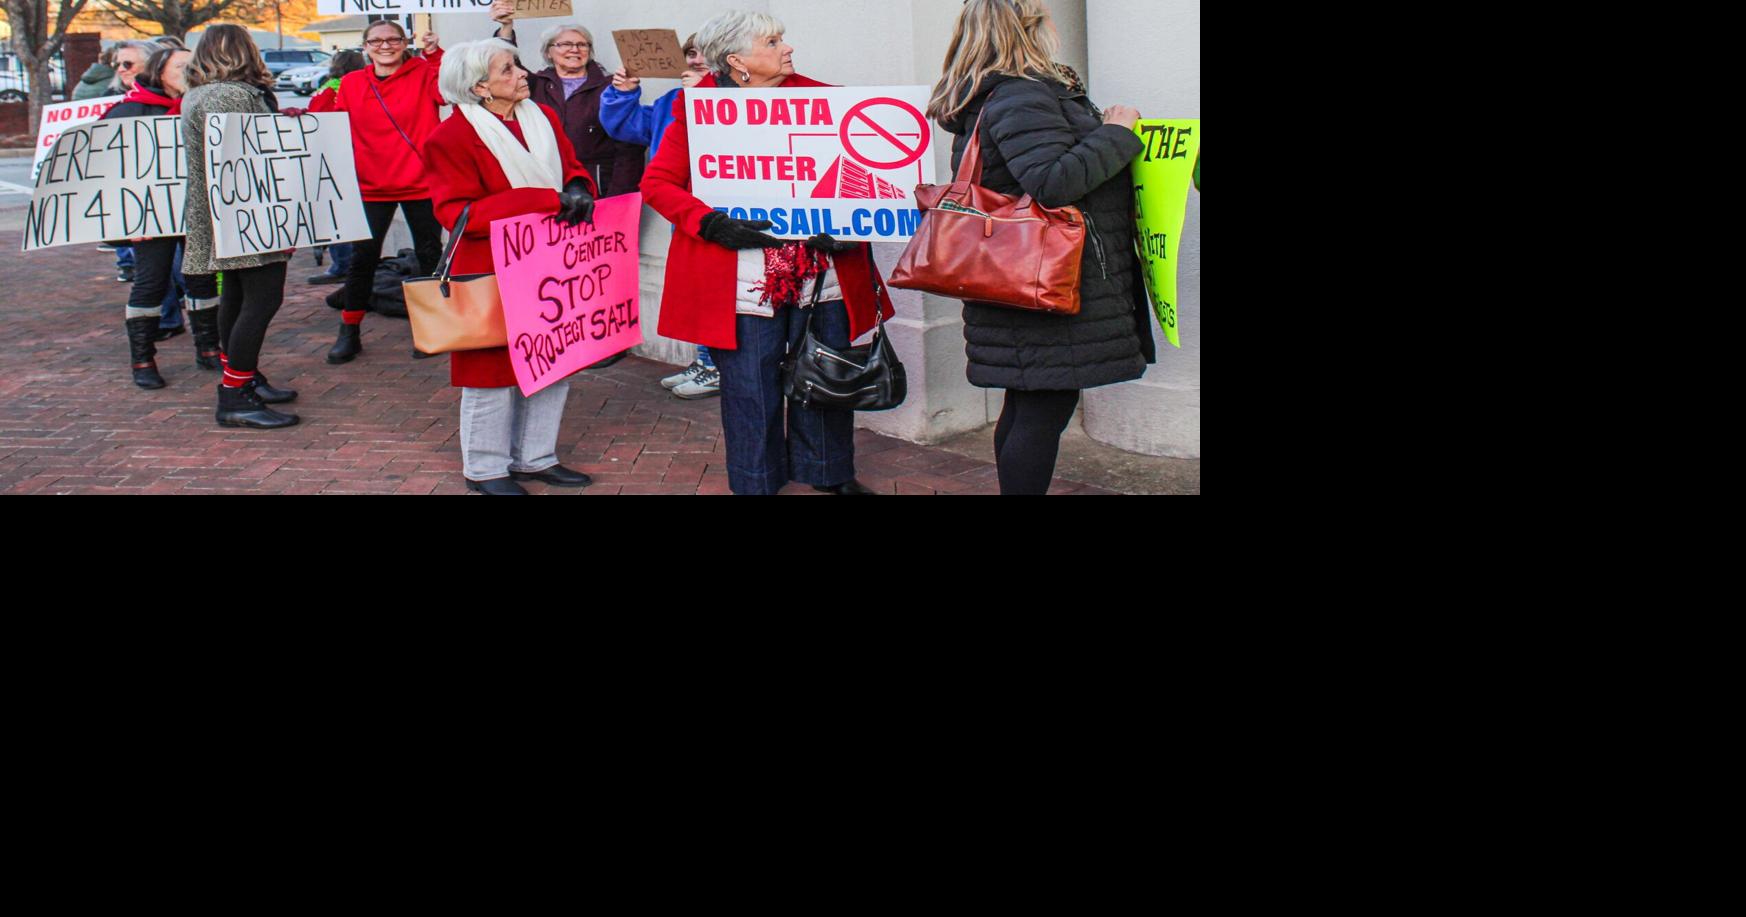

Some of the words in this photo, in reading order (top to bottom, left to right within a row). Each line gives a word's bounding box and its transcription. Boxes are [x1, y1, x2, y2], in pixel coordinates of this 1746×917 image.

[47, 108, 72, 123] NO
[77, 102, 114, 119] DAT
[693, 98, 738, 125] NO
[746, 98, 834, 126] DATA
[107, 123, 129, 179] 4
[135, 117, 188, 180] DEE
[241, 114, 319, 155] KEEP
[1141, 124, 1192, 162] THE
[220, 153, 343, 205] COWETA
[698, 154, 817, 182] CENTER
[24, 192, 78, 250] NOT
[84, 190, 111, 238] 4
[121, 182, 186, 236] DAT
[236, 200, 340, 253] RURAL!
[713, 206, 922, 237] PSAIL.COM
[502, 222, 535, 267] NO
[563, 231, 628, 270] CENTER
[538, 263, 612, 323] STOP
[515, 314, 586, 382] PROJECT
[590, 298, 639, 341] SAIL
